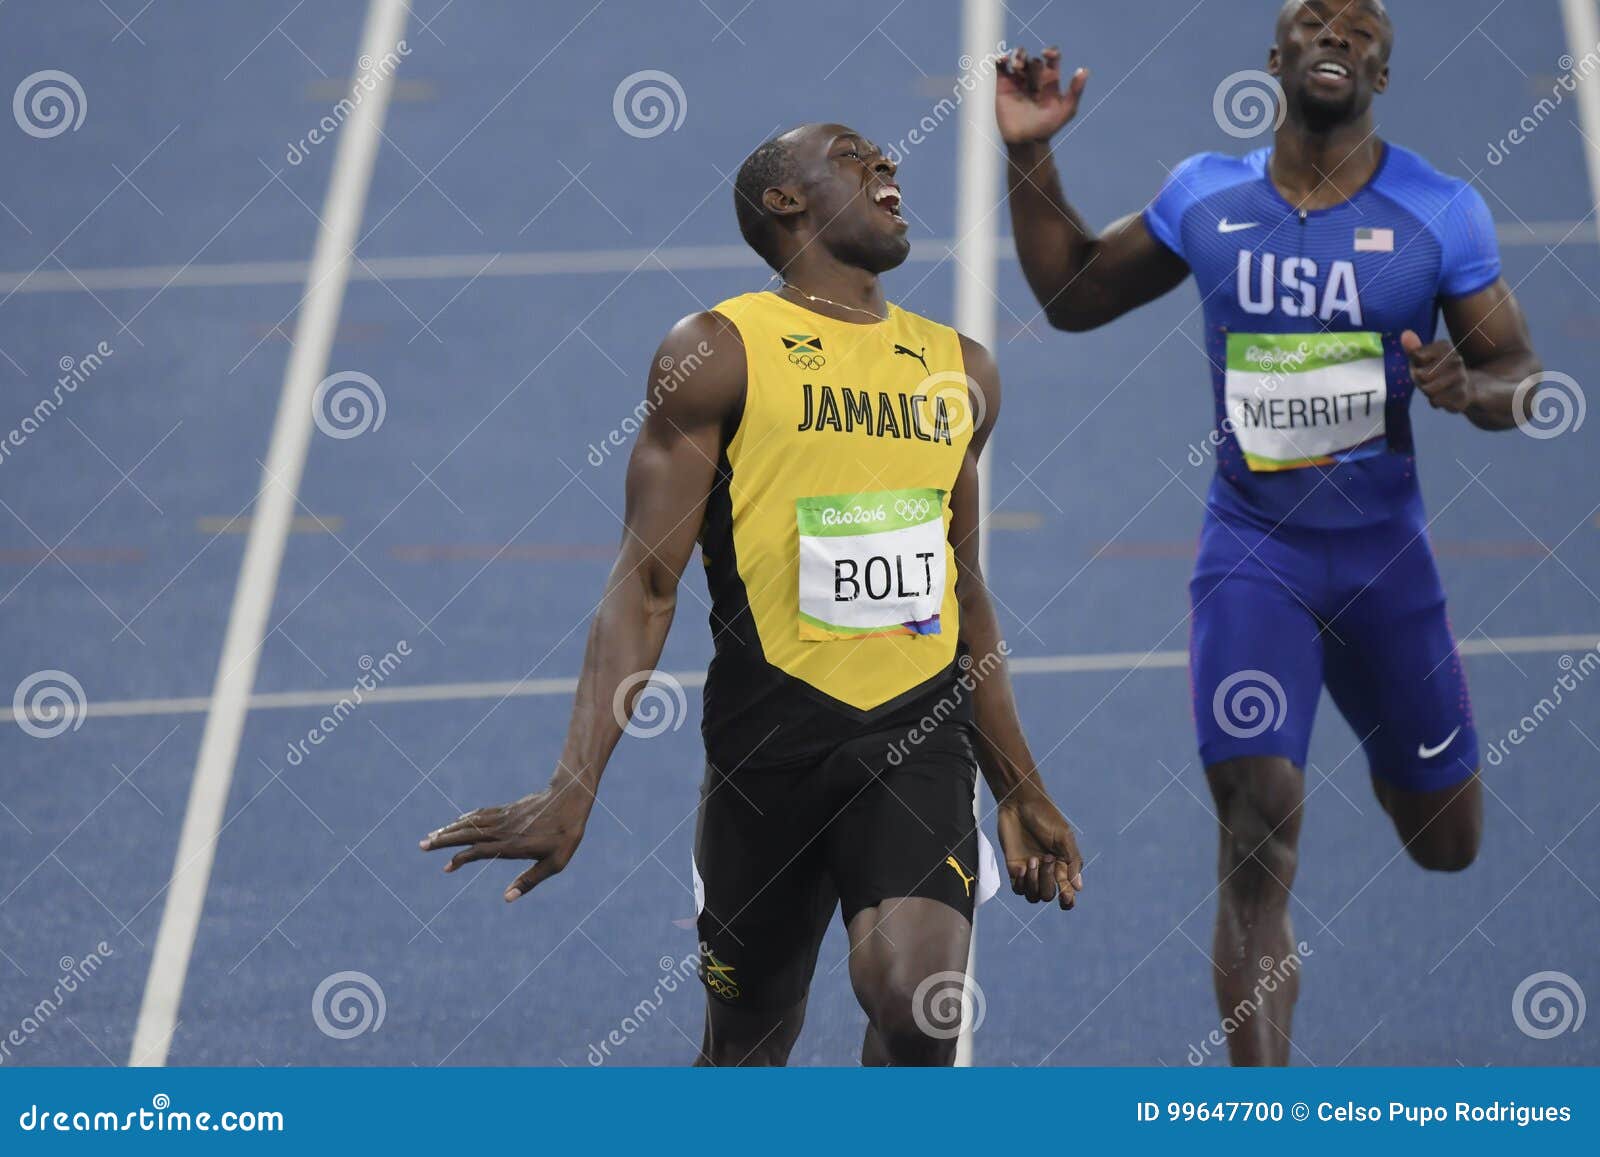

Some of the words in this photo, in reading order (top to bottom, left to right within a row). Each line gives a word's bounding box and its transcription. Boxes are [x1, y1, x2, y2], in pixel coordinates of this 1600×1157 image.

[1237, 250, 1363, 326] USA
[798, 384, 952, 446] JAMAICA
[1243, 389, 1377, 430] MERRITT
[822, 504, 886, 526] Rio2016
[834, 552, 934, 602] BOLT
